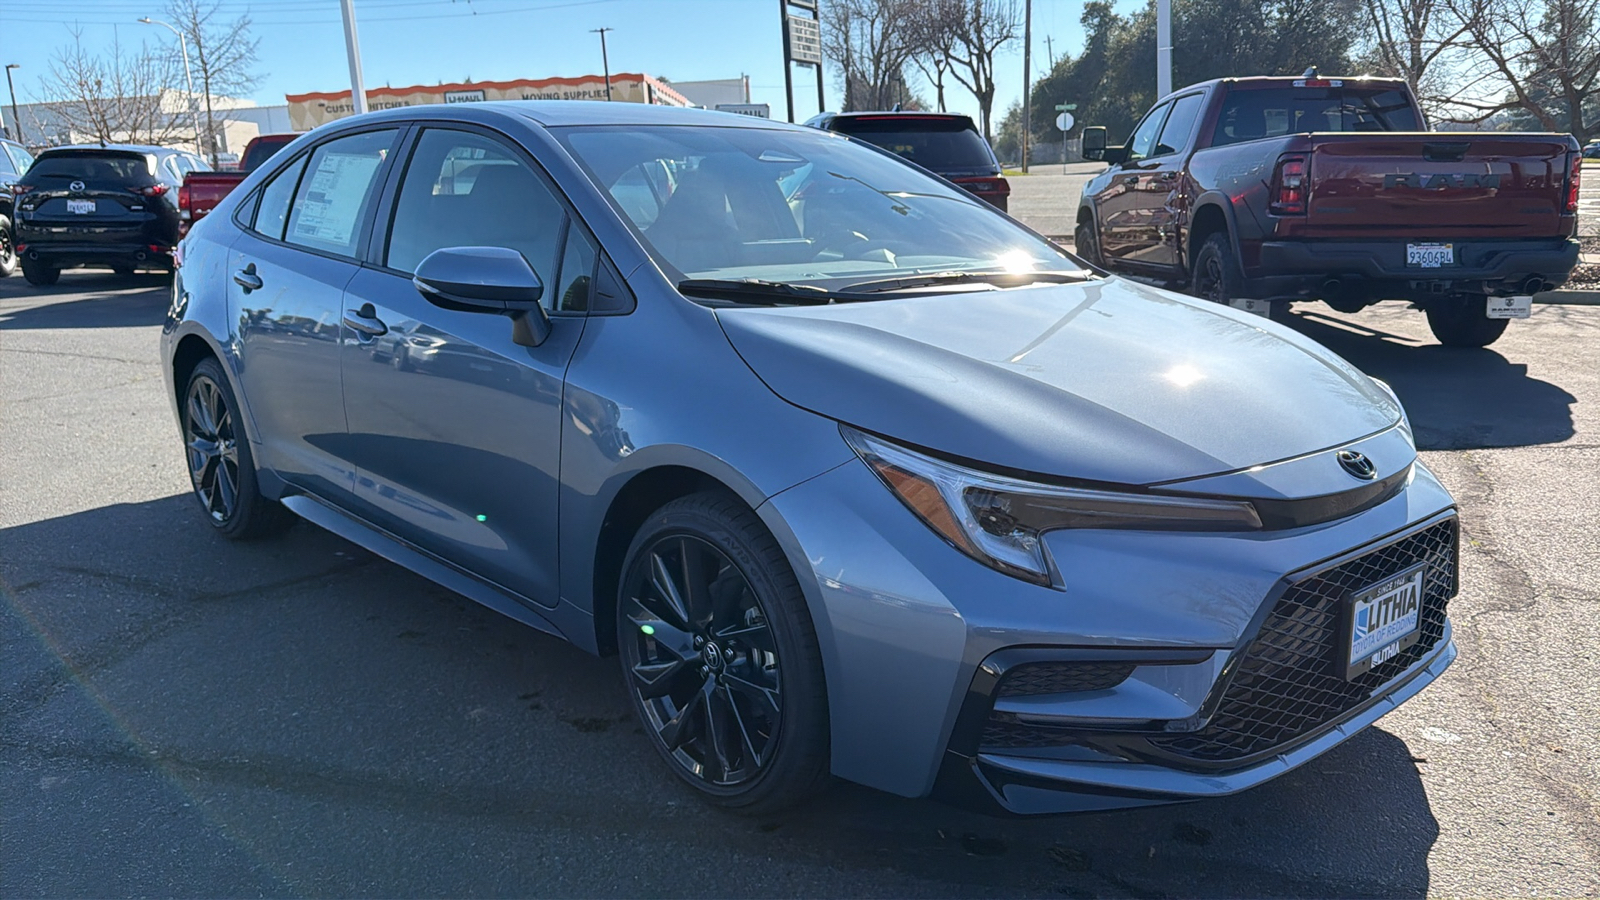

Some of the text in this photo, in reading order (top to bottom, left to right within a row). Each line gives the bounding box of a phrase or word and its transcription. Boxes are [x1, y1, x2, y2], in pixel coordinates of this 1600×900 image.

[448, 95, 481, 103] U-HAUL
[522, 90, 608, 100] MOVING SUPPLIES
[369, 101, 410, 111] HITCHES
[1384, 173, 1500, 189] RAM
[1377, 581, 1393, 596] SINCE
[1367, 584, 1417, 634] LITHIA
[1352, 613, 1417, 655] TOYOTA OF REDDING
[1377, 640, 1400, 665] LITHIA
